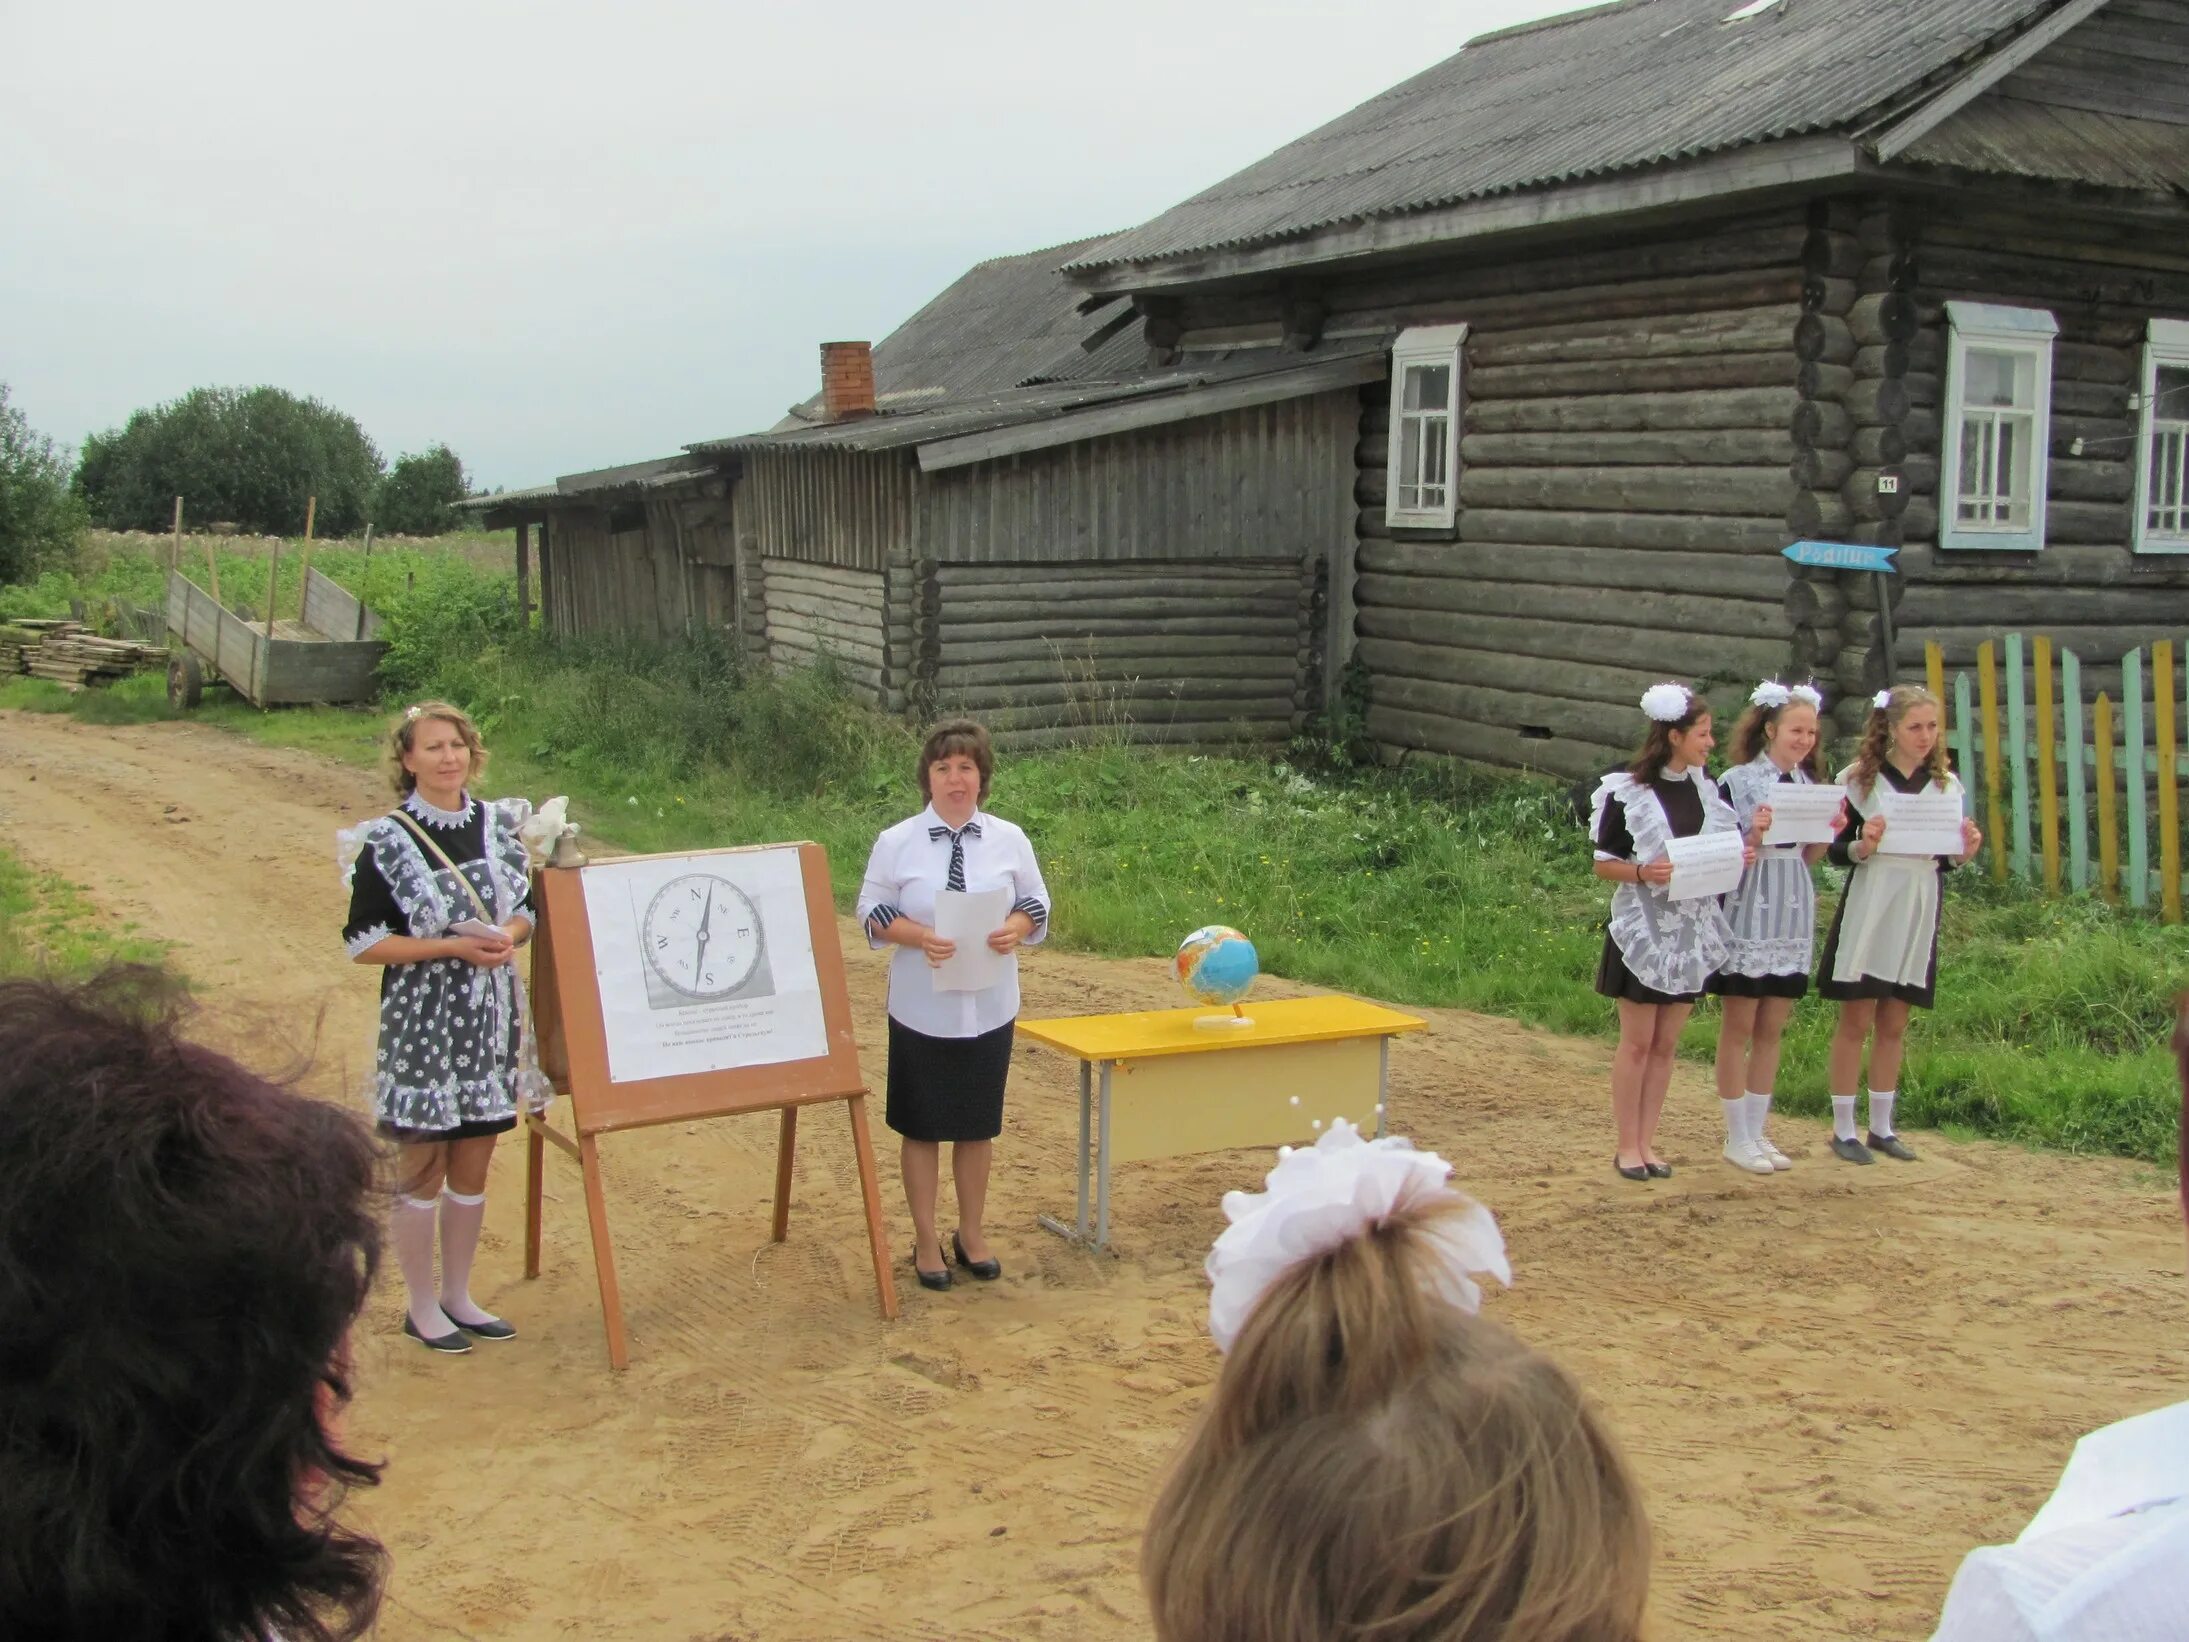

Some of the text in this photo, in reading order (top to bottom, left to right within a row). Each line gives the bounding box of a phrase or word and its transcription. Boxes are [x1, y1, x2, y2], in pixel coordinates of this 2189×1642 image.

[1882, 479, 1895, 489] 11
[690, 888, 702, 901] N
[737, 928, 750, 939] E
[656, 935, 669, 950] W
[705, 973, 714, 986] S
